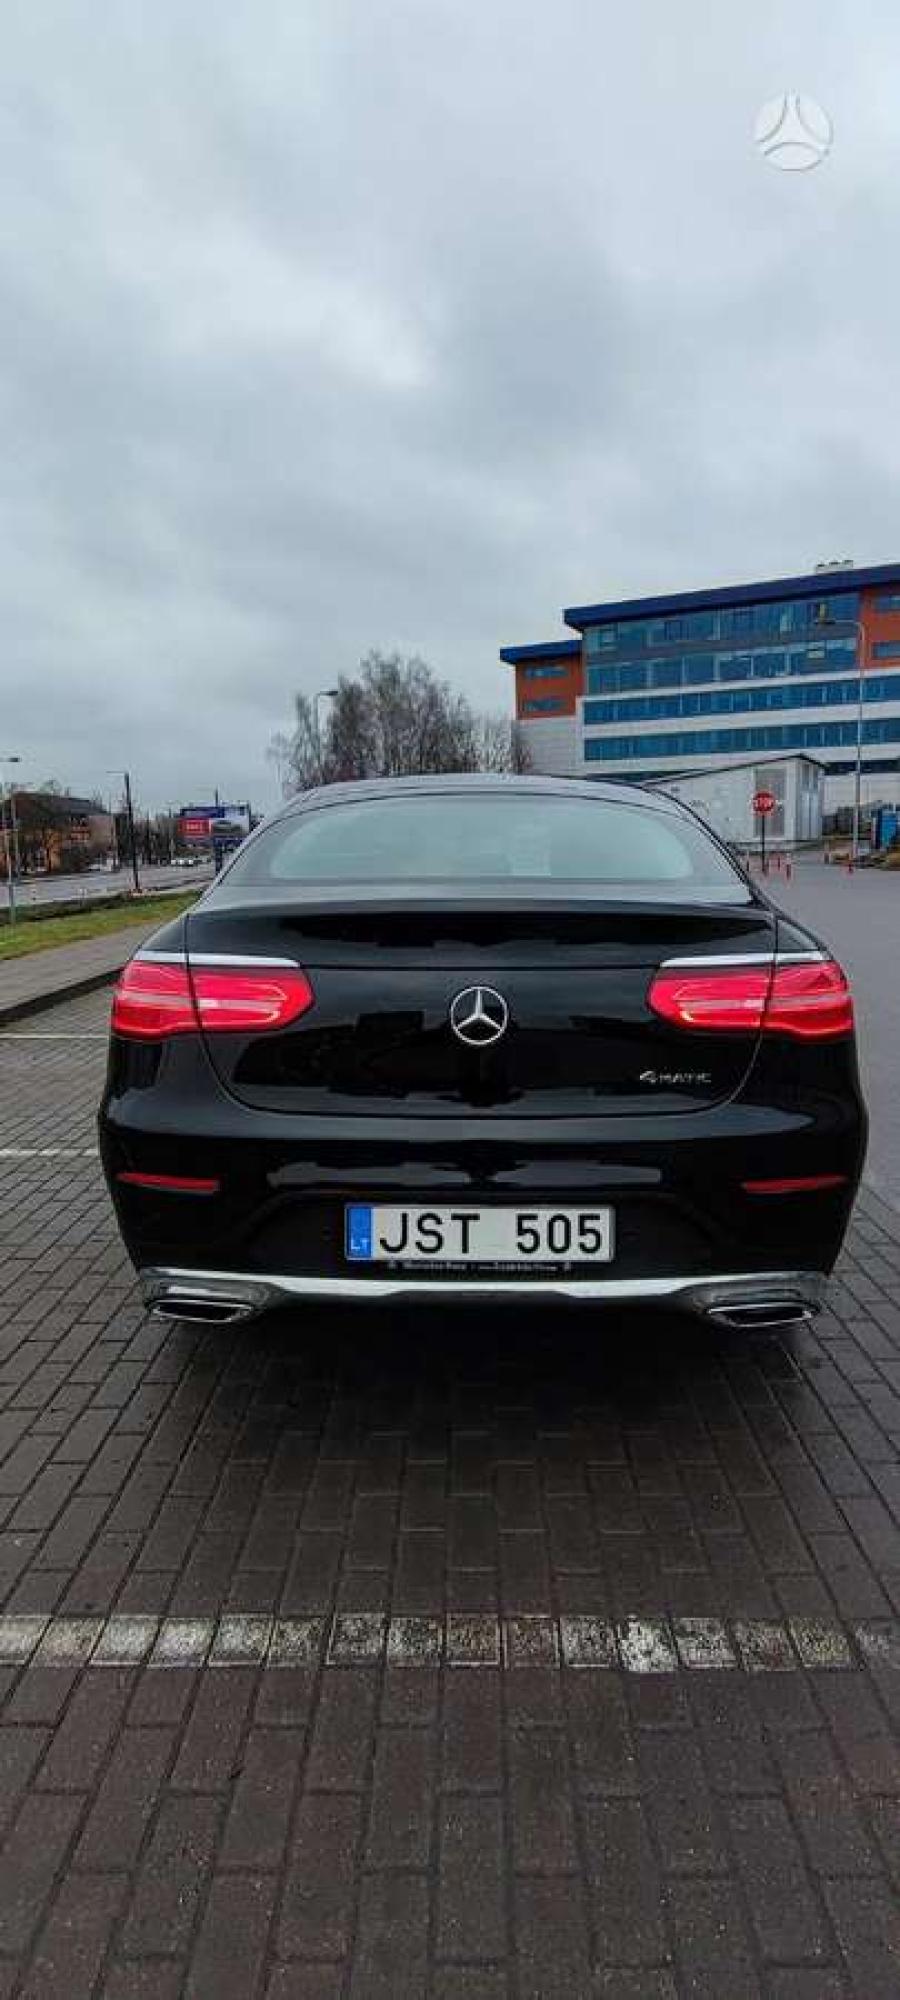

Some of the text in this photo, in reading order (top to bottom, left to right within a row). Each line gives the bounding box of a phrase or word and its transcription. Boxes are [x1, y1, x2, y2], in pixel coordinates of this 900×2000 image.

[350, 1237, 368, 1250] LT
[379, 1212, 602, 1254] JST 505
